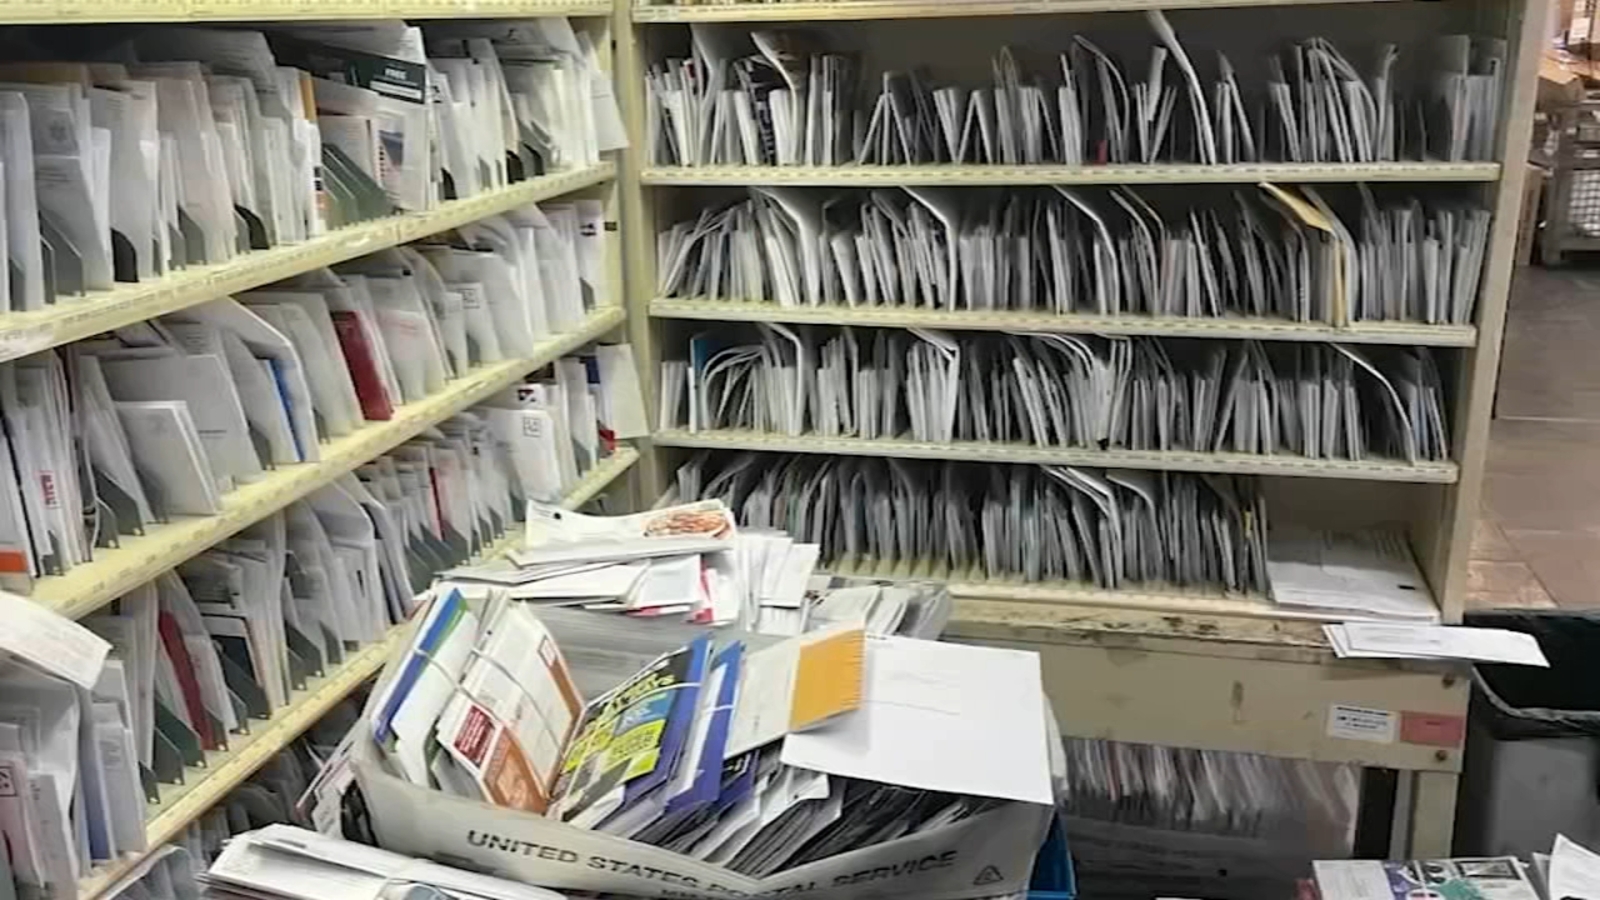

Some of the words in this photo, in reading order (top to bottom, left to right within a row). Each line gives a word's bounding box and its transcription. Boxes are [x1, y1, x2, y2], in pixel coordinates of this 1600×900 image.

[466, 829, 579, 864] UNITED
[586, 855, 699, 888] STATES
[831, 849, 958, 887] SERVICE
